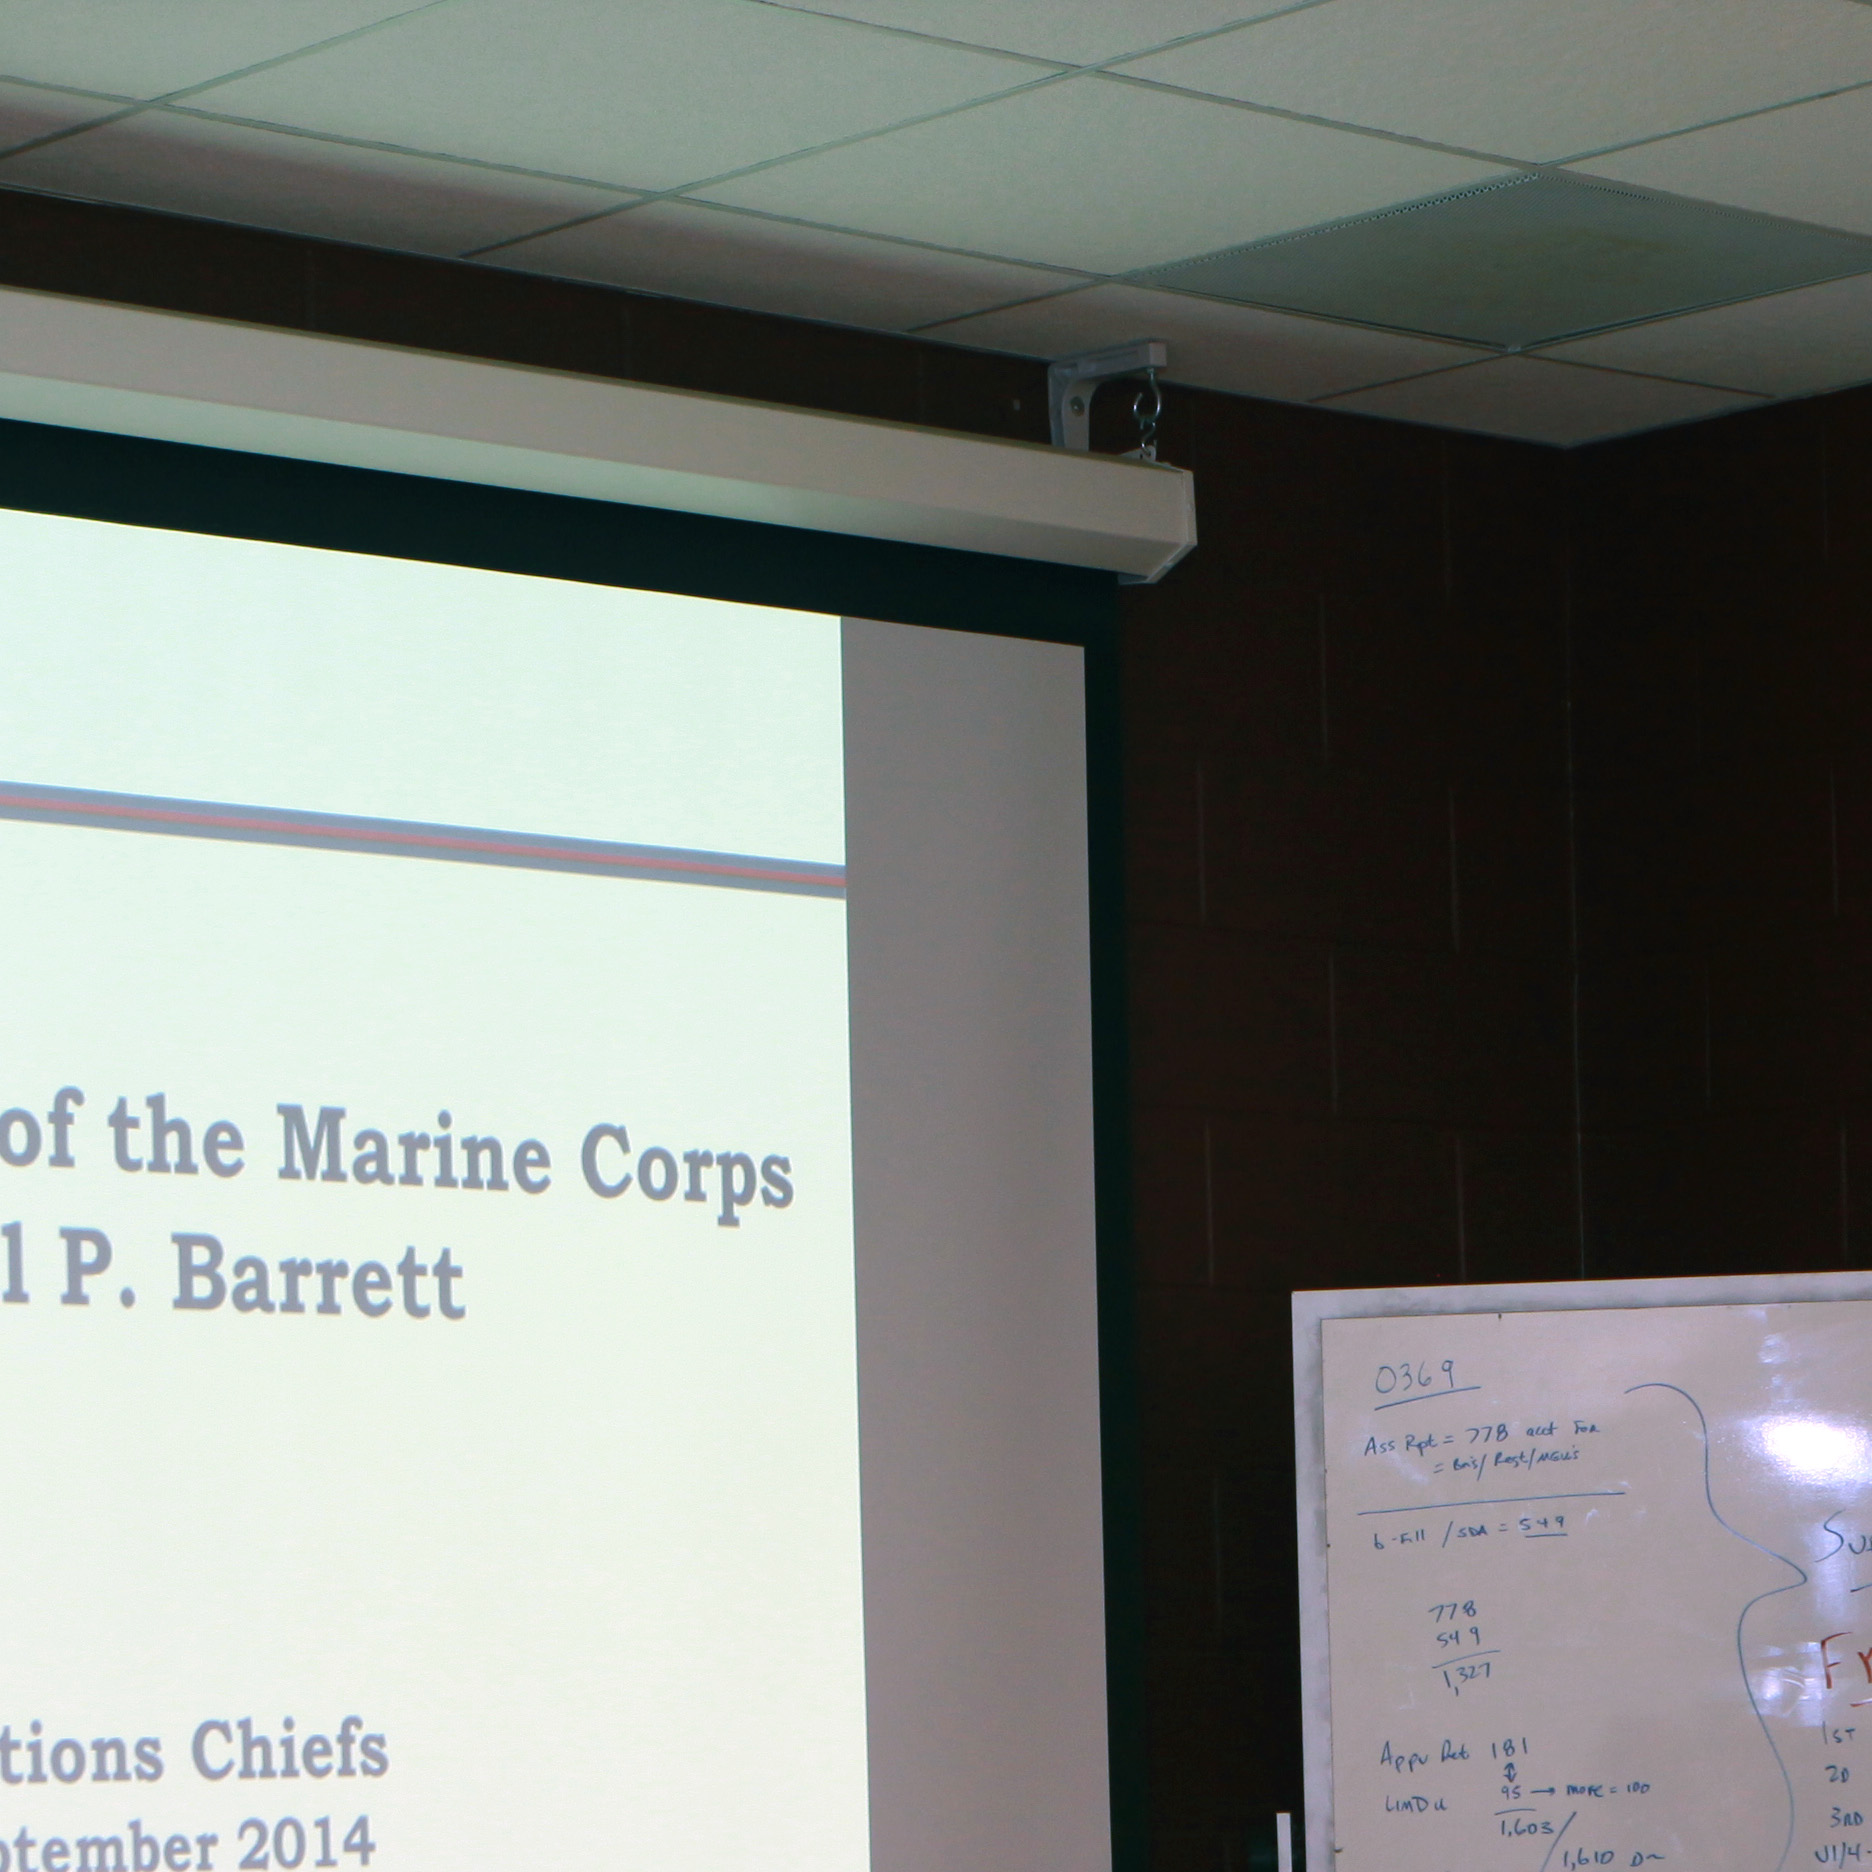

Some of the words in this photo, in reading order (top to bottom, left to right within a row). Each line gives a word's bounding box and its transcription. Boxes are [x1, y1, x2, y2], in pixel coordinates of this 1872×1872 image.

[107, 1092, 244, 1178] the
[276, 1103, 551, 1195] Marine
[581, 1123, 793, 1228] Corps
[59, 1227, 135, 1309] P.
[171, 1232, 466, 1321] Barrett
[1375, 1359, 1455, 1394] 0369
[1465, 1423, 1510, 1444] 778
[1428, 1600, 1477, 1623] 778
[1436, 1626, 1481, 1648] 549
[191, 1715, 389, 1781] Chiefs
[1491, 1737, 1529, 1760] 181
[238, 1815, 376, 1871] 2014
